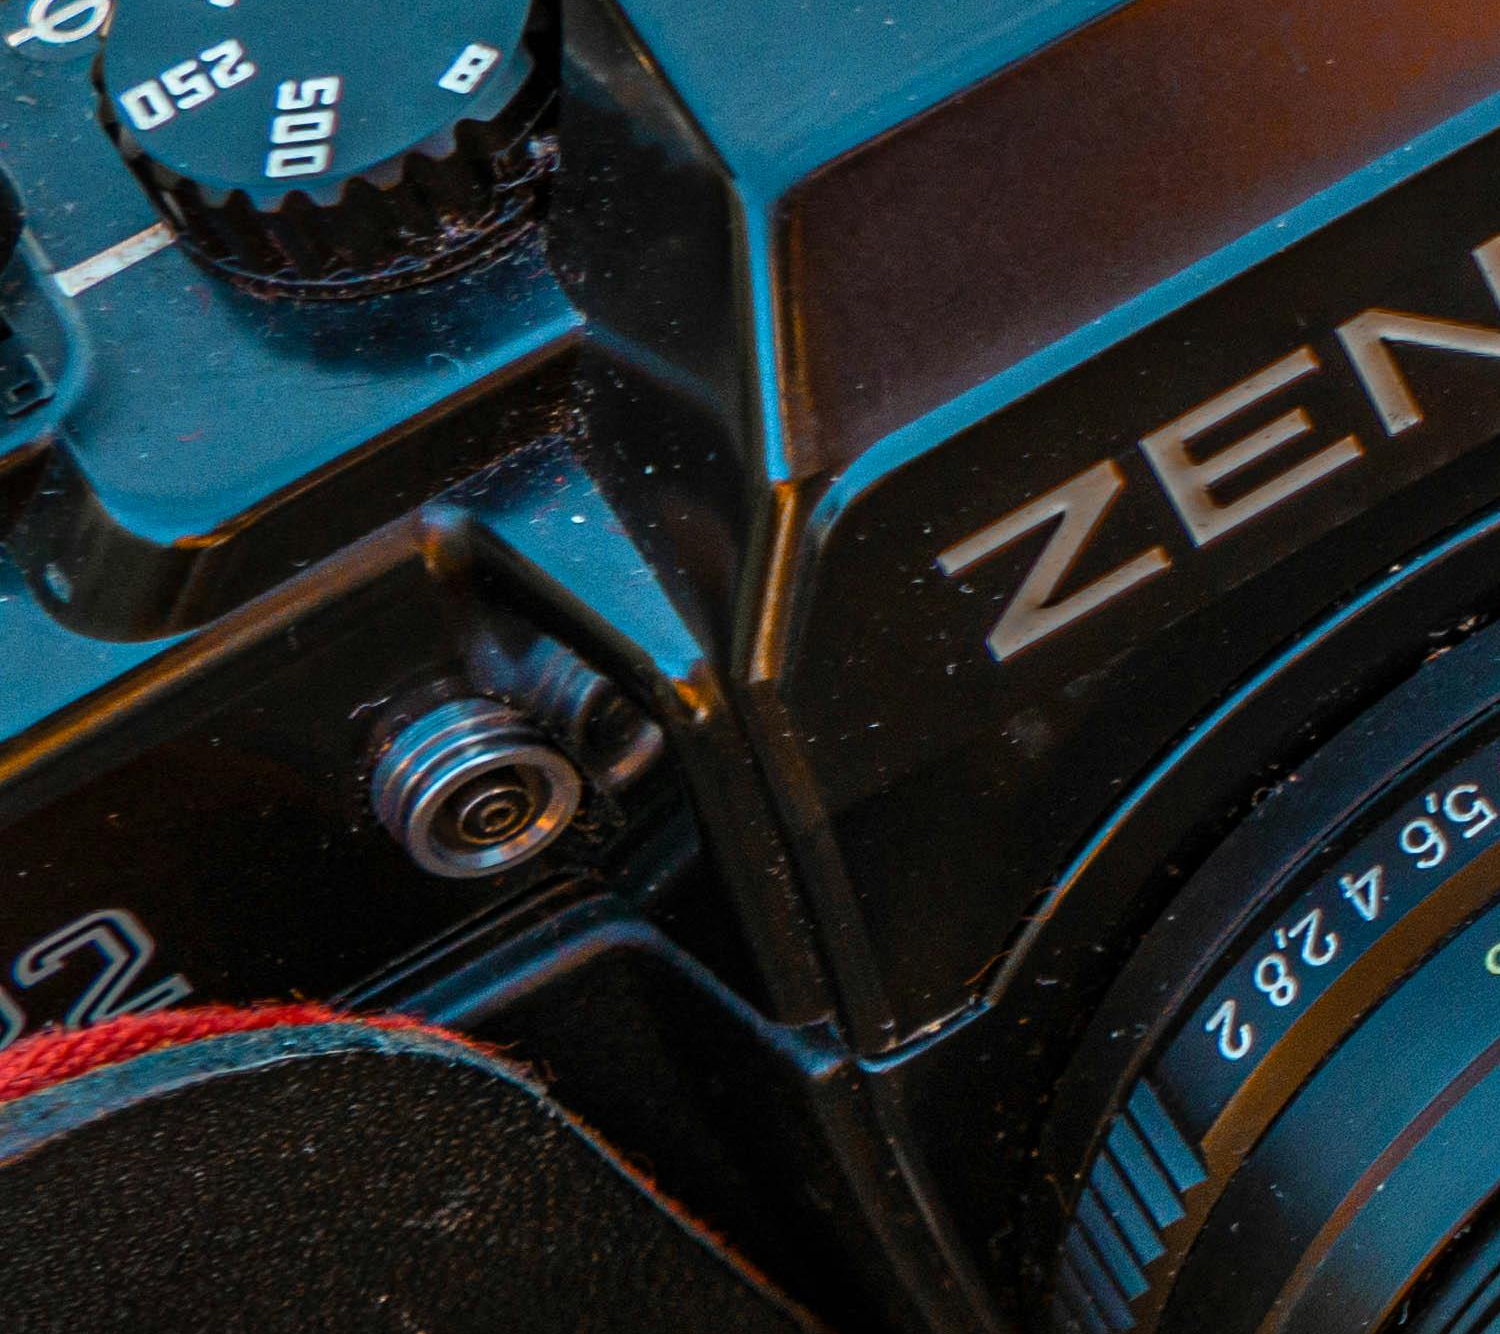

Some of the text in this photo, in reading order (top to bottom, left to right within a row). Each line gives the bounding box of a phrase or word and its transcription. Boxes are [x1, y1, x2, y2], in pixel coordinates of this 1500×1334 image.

[118, 40, 256, 131] 250
[264, 75, 340, 179] 500
[1338, 865, 1384, 922] 4
[0, 908, 194, 1050] 2
[1204, 999, 1254, 1060] 2
